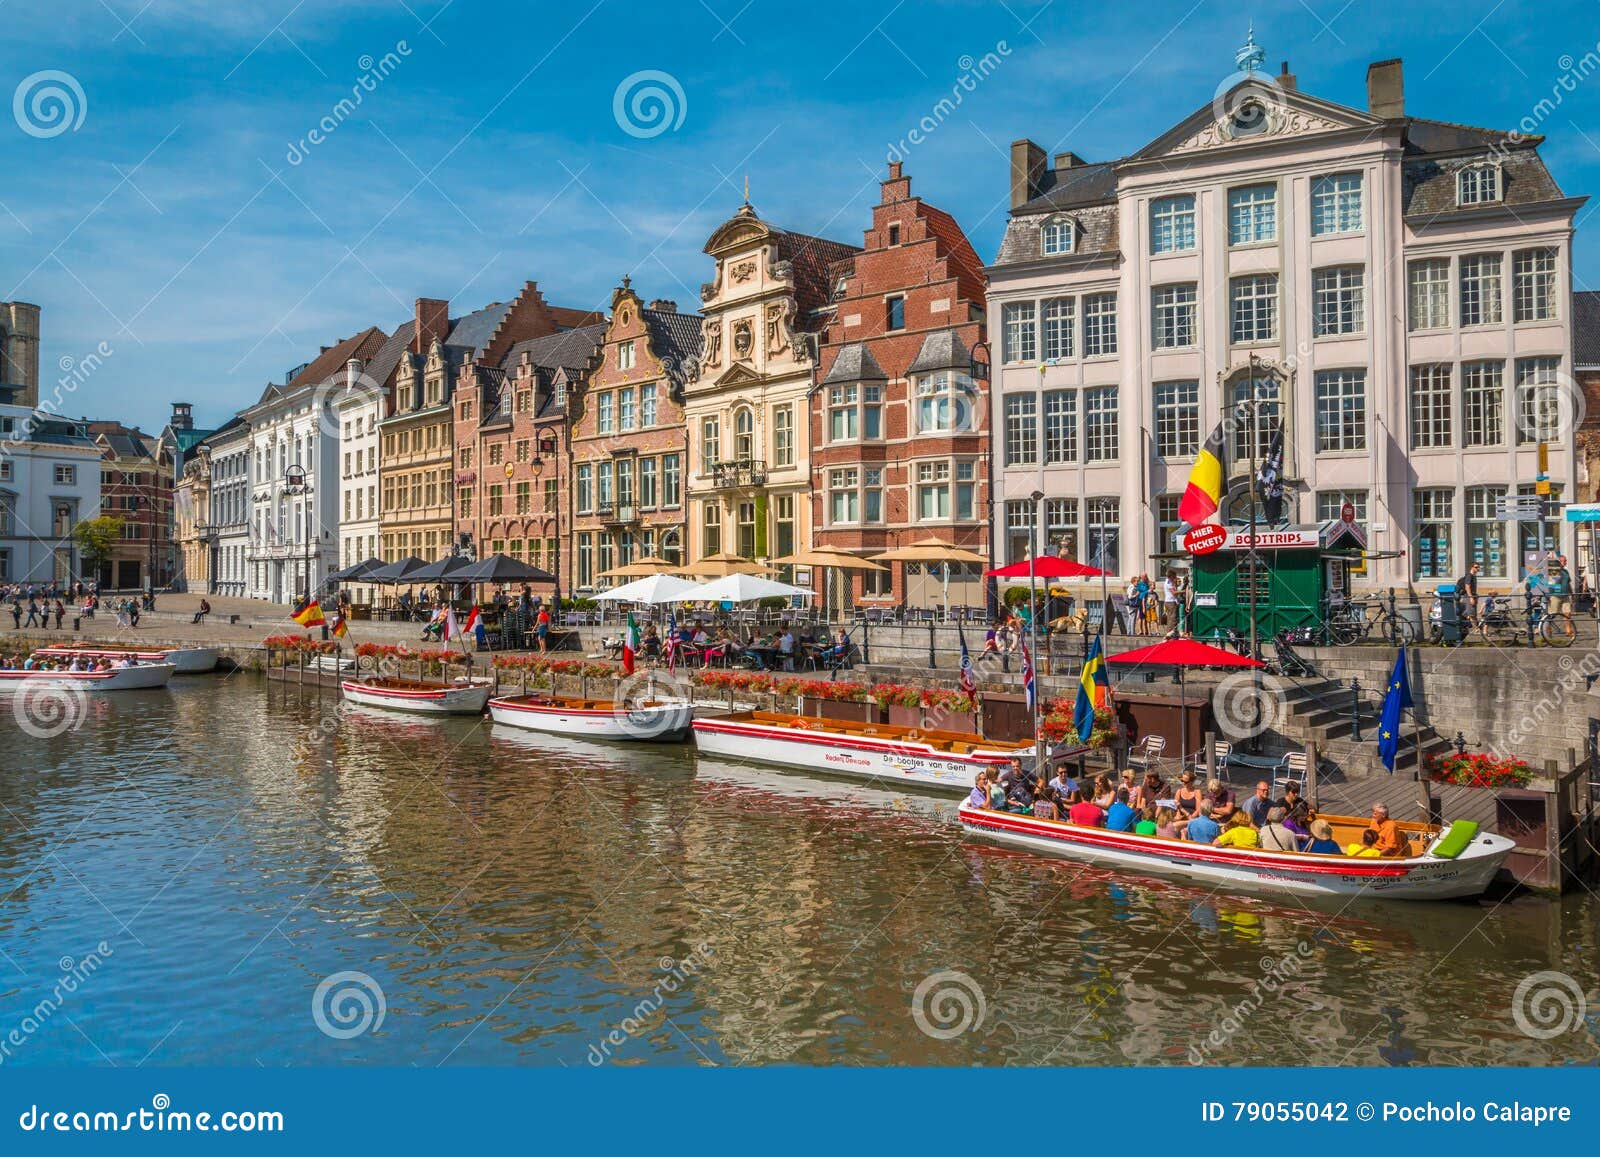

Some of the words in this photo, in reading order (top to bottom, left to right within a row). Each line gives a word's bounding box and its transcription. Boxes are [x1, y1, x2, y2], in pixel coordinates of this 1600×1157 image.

[1191, 526, 1213, 540] HIER
[1235, 533, 1302, 545] BOOTTRIPS
[1188, 534, 1223, 552] TICKETS
[883, 754, 894, 763] De
[897, 755, 925, 769] bootjes
[928, 761, 943, 769] van
[947, 761, 966, 772] Gent
[1362, 876, 1400, 886] bootjes
